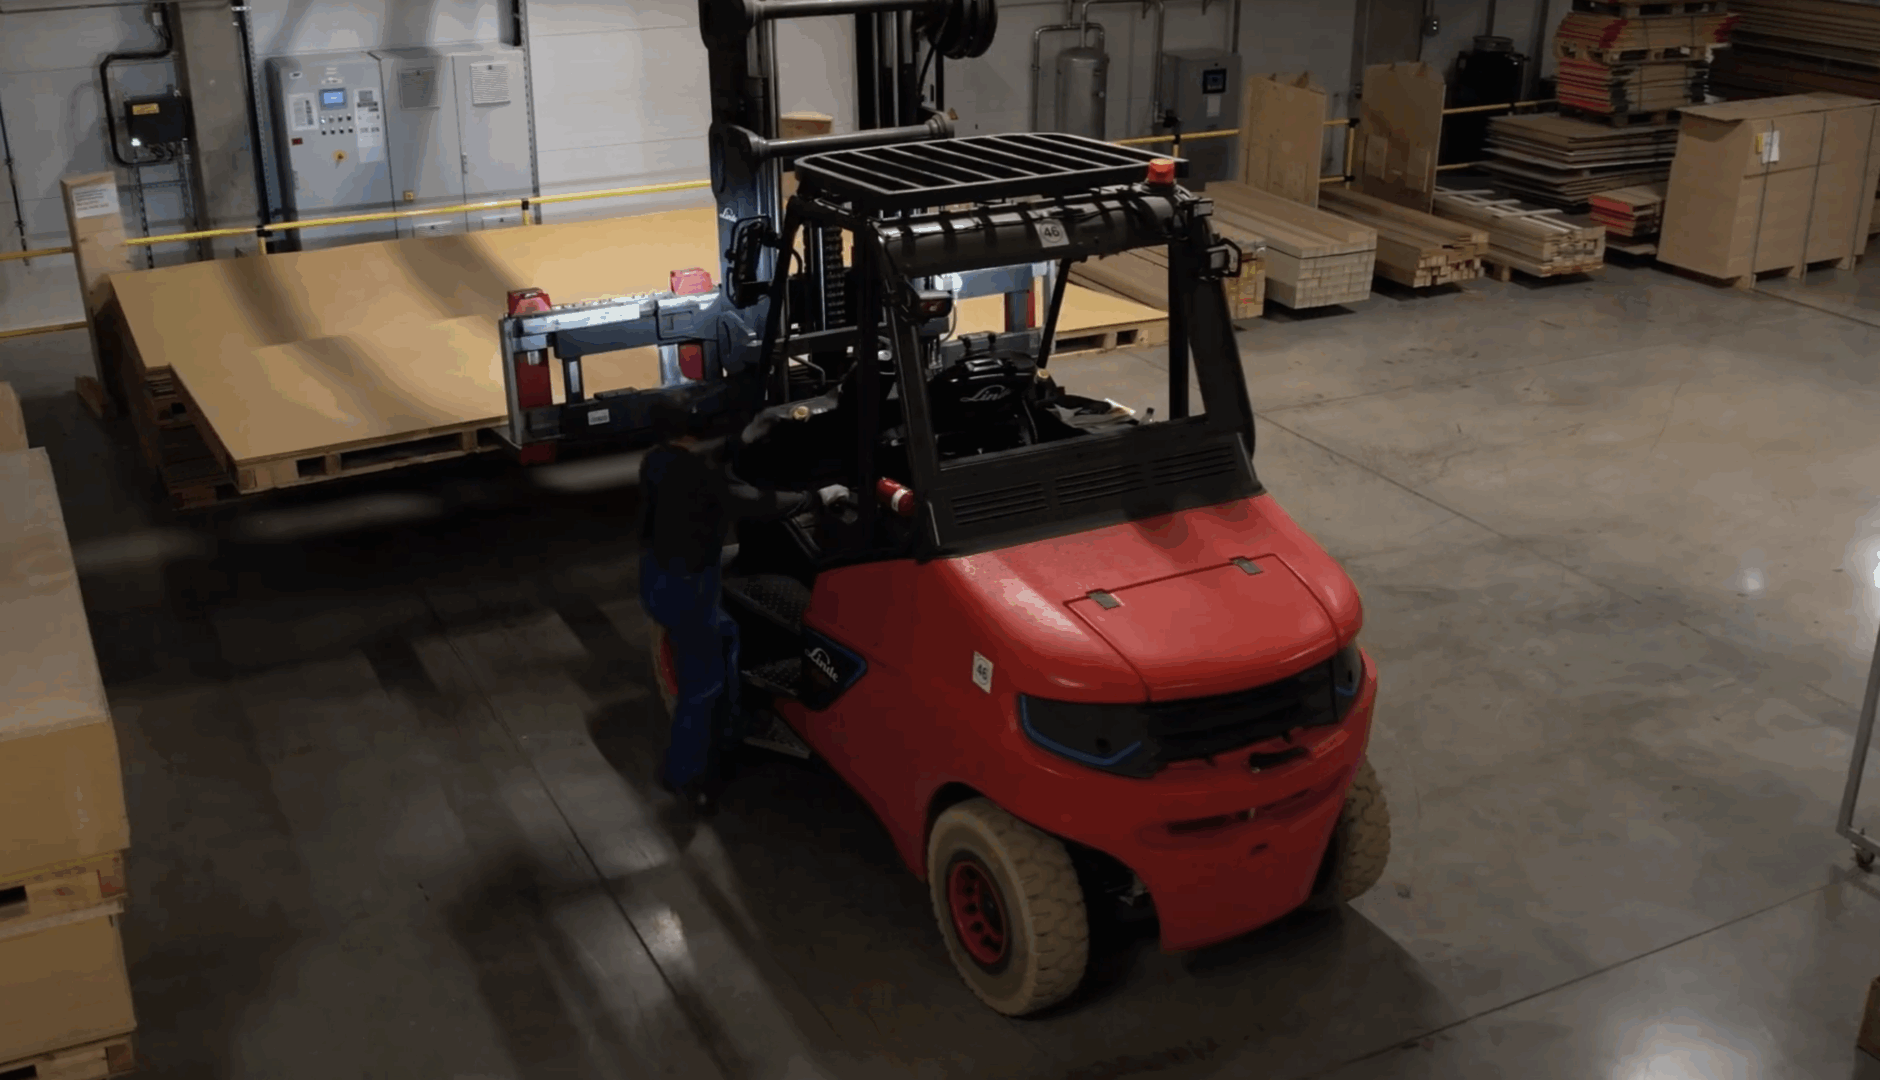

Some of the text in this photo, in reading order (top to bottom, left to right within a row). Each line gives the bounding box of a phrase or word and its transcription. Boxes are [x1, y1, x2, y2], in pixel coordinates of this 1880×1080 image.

[1044, 226, 1060, 237] 46
[960, 384, 1011, 402] Lin
[804, 647, 839, 683] Linde
